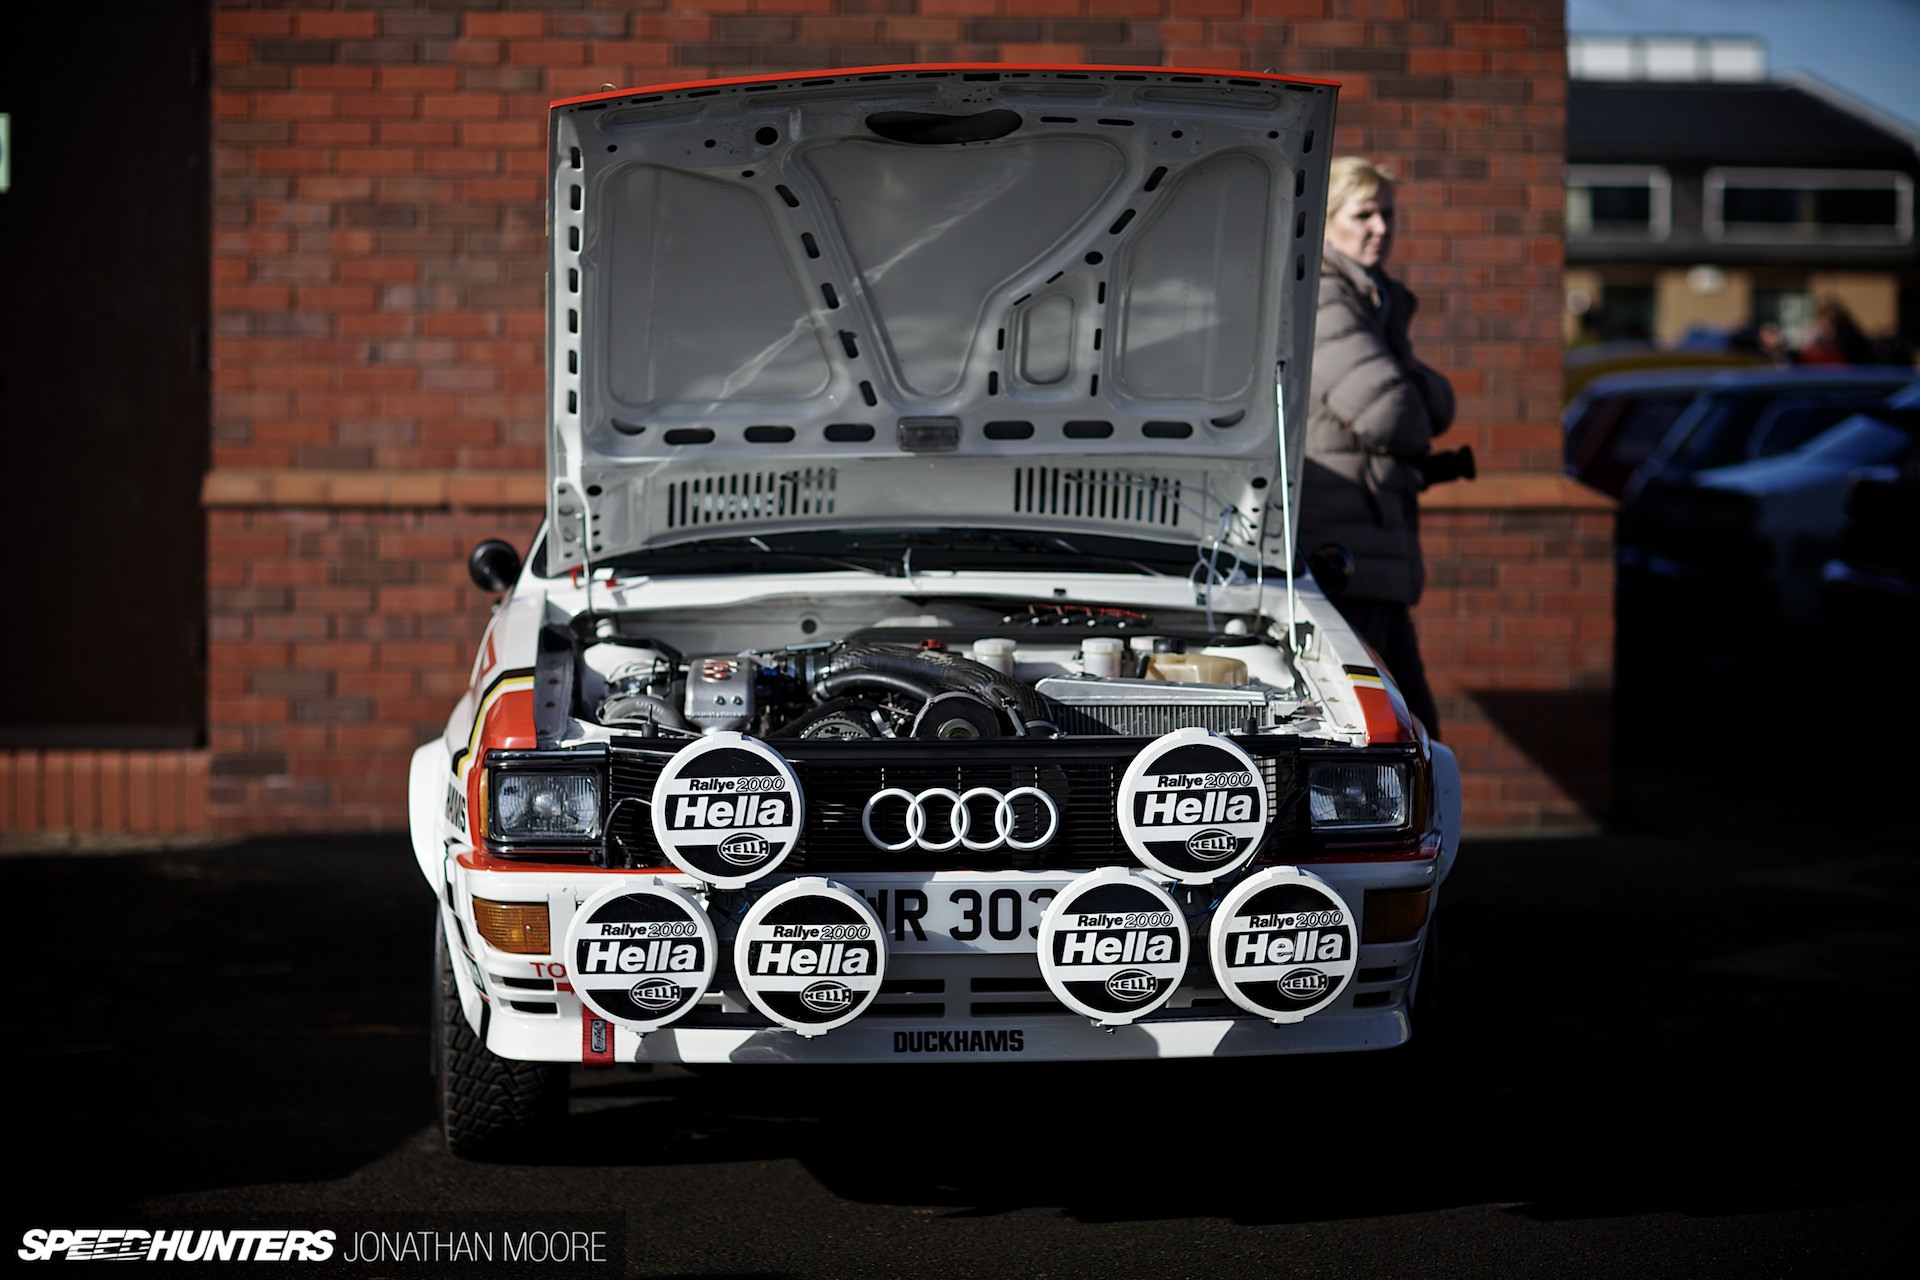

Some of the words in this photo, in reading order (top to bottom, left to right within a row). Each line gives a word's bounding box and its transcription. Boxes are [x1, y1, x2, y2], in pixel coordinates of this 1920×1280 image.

[689, 778, 735, 792] Rallye
[735, 777, 785, 792] 2000
[1157, 775, 1203, 789] Rallye
[1204, 772, 1252, 788] 2000
[674, 795, 785, 828] Hella
[1142, 791, 1252, 824] Hella
[722, 840, 768, 854] HELLA
[1190, 836, 1236, 850] HELLA
[1077, 915, 1123, 928] Rallye
[1124, 913, 1173, 928] 2000
[1249, 914, 1294, 929] Rallye
[1295, 911, 1343, 928] 2000
[601, 923, 646, 937] Rallye
[647, 922, 697, 937] 2000
[773, 926, 819, 939] Rallye
[820, 925, 870, 940] 2000
[1061, 931, 1173, 963] Hella
[1234, 930, 1343, 965] Hella
[585, 940, 697, 972] Hella
[756, 943, 869, 974] Hella
[1110, 976, 1156, 990] HELLA
[1282, 974, 1327, 989] HELLA
[634, 985, 680, 999] HELLA
[805, 988, 851, 1002] HELLA
[894, 1030, 1024, 1052] DUCKHAMS
